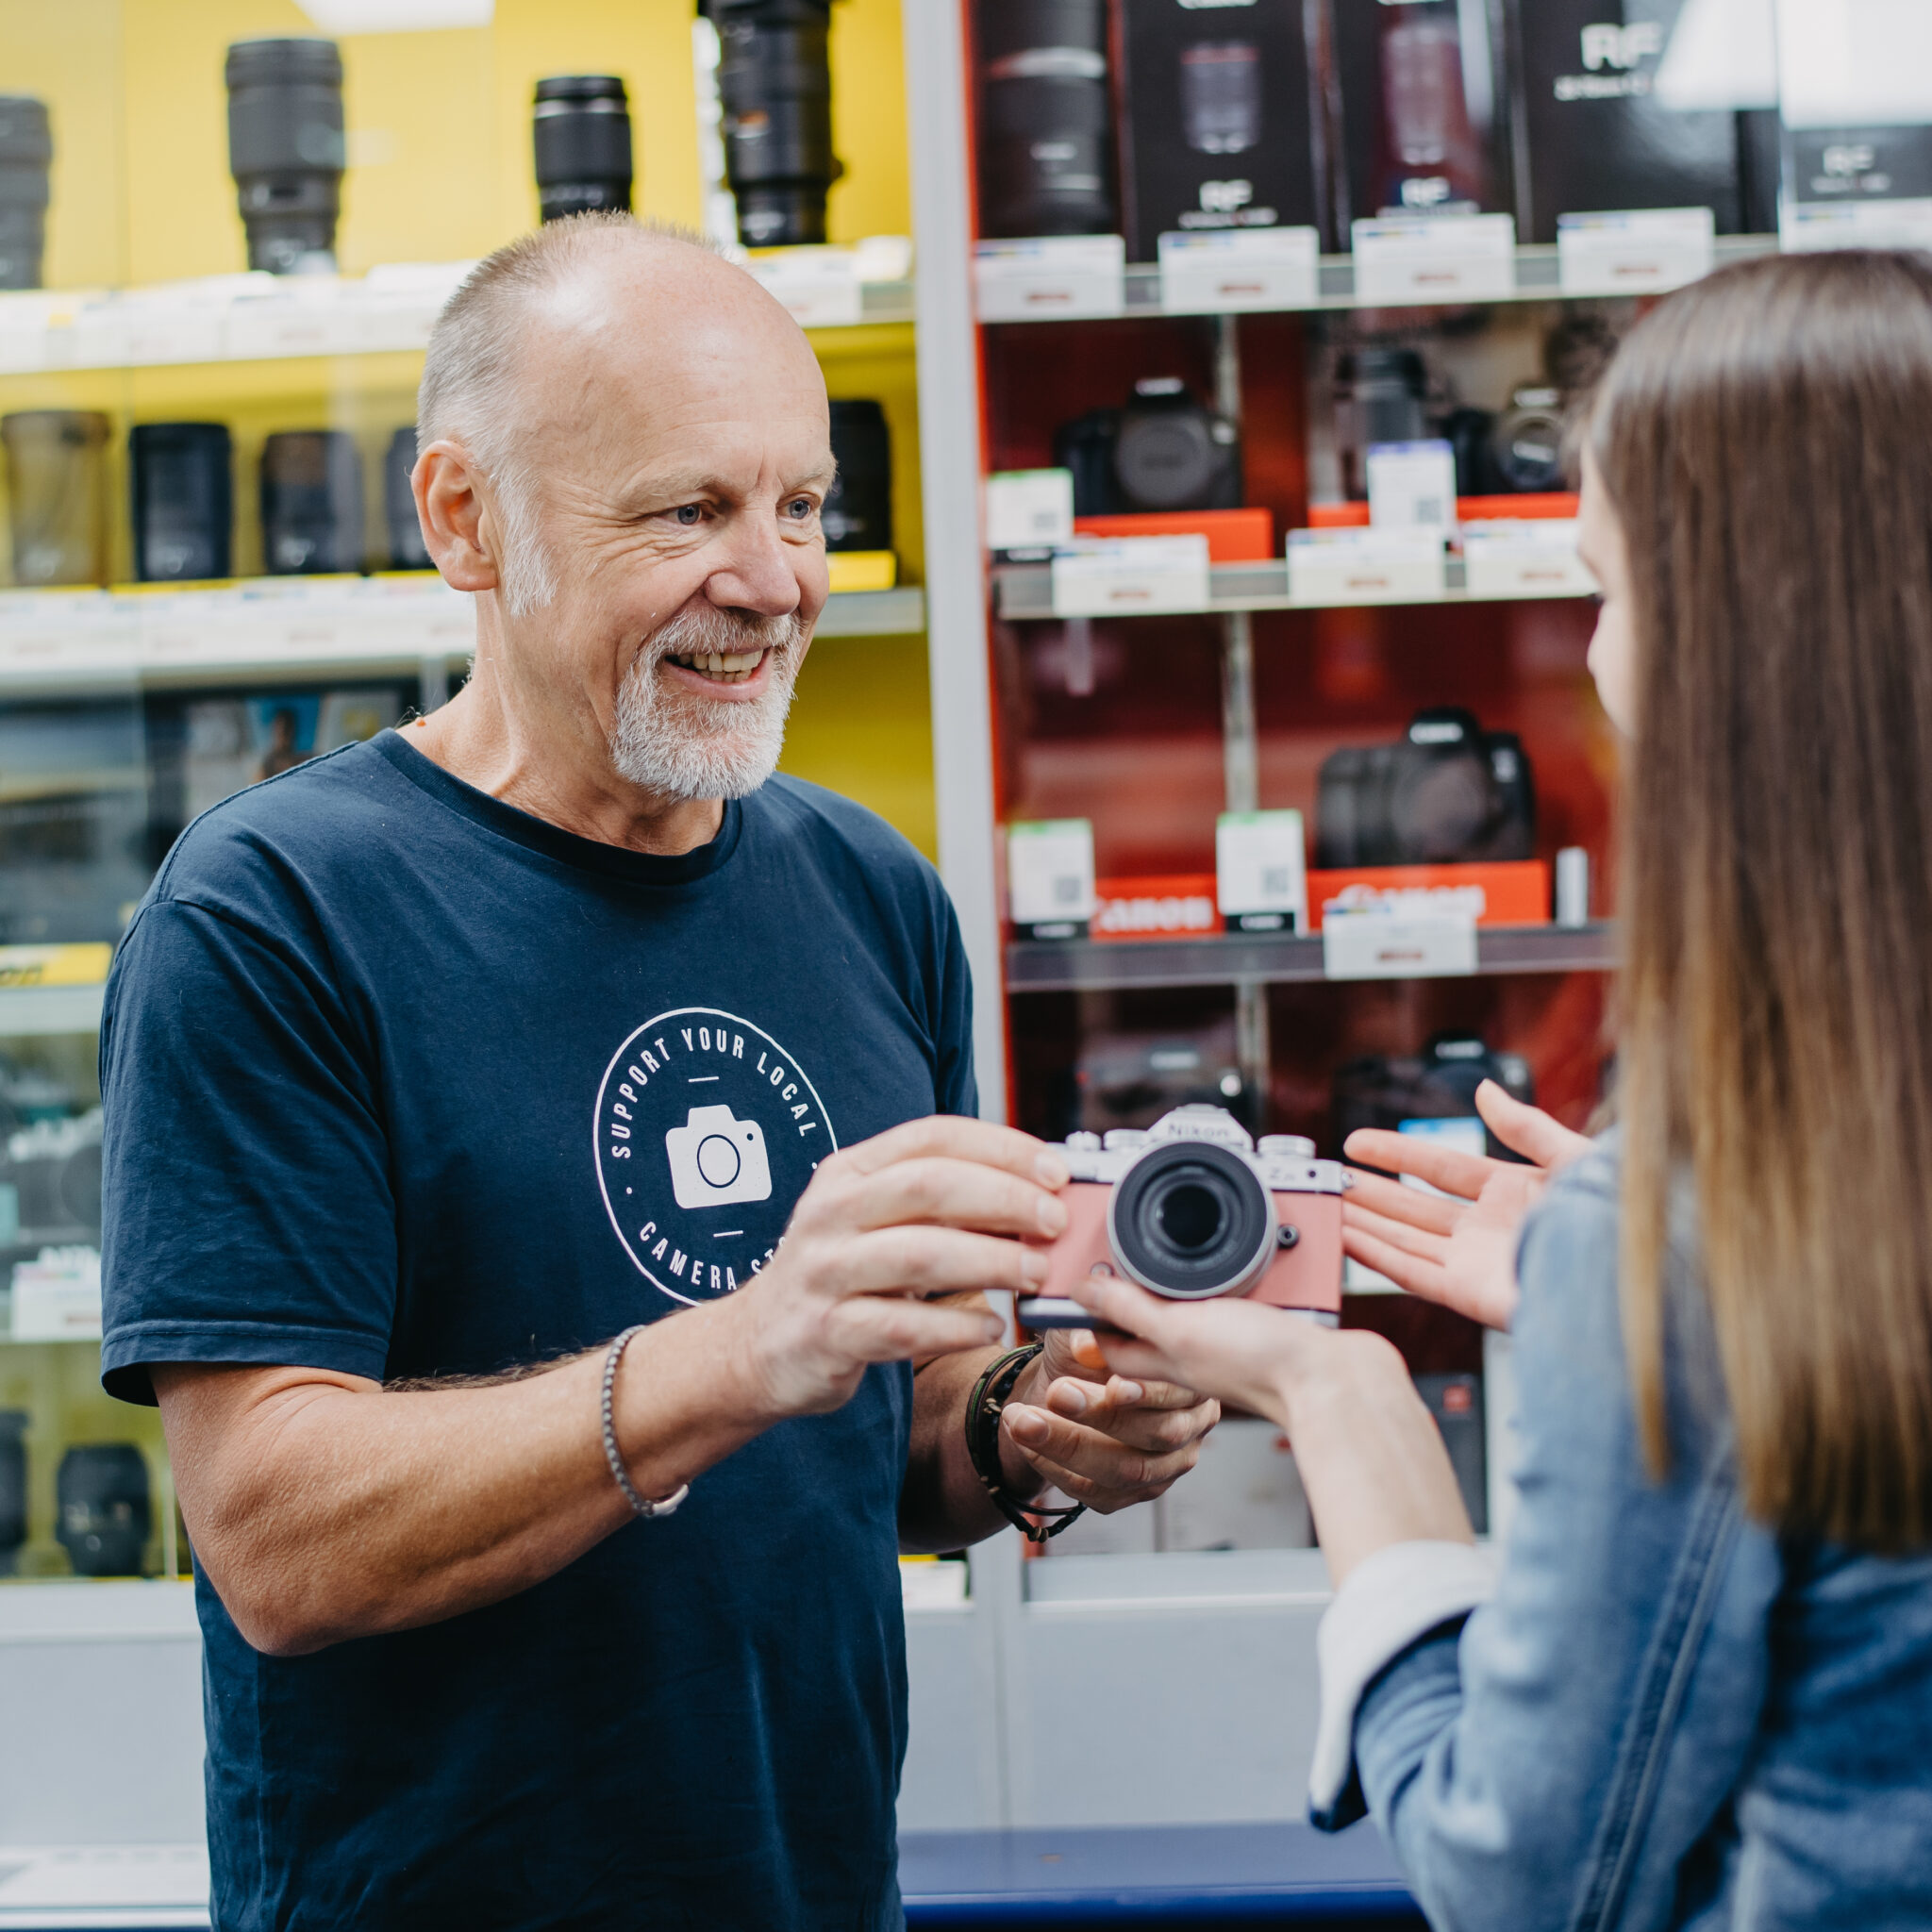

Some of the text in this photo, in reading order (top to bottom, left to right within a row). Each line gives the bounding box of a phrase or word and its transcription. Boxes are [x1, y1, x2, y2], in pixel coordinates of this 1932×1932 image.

[1580, 23, 1662, 71] RF
[611, 1026, 817, 1158] SUPPORT YOUR LOCAL
[1168, 1124, 1229, 1138] Nikon
[640, 1222, 738, 1290] CAMERA
